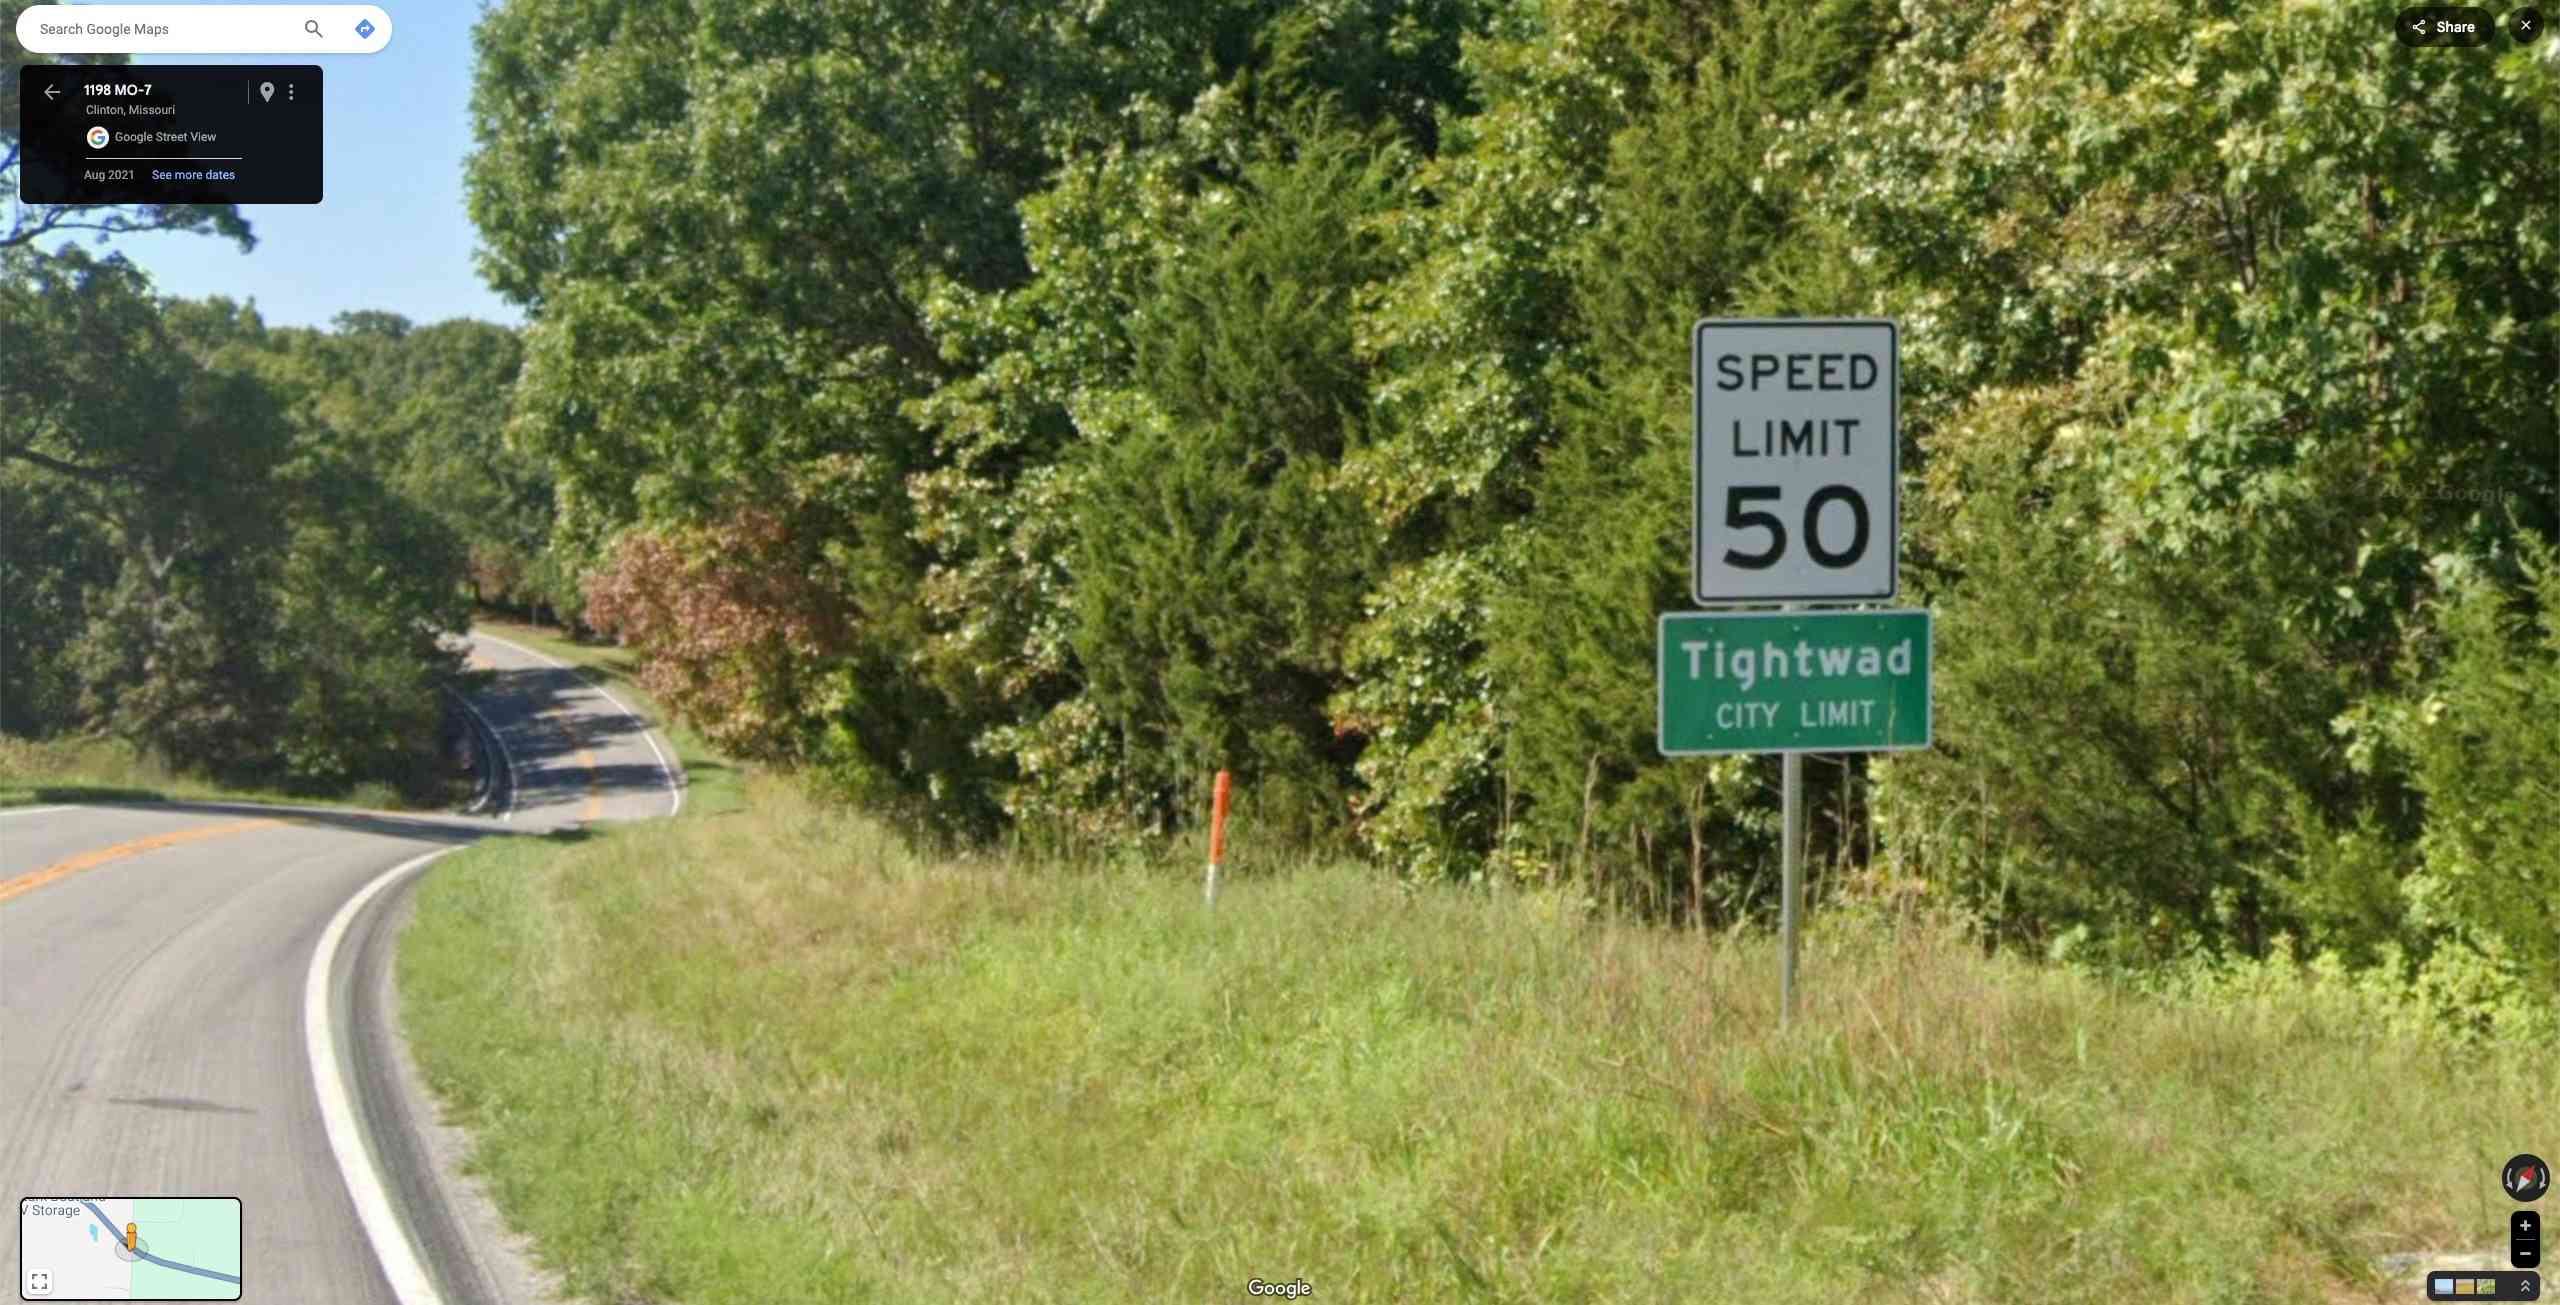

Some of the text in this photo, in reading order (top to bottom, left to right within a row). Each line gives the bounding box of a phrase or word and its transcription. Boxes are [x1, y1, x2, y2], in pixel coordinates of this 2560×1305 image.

[1716, 353, 1879, 393] SPEED
[1732, 418, 1861, 458] LIMIT
[1722, 482, 1872, 571] 50
[1681, 638, 1913, 691] Tightwad
[1716, 699, 1876, 729] CITY LIMIT
